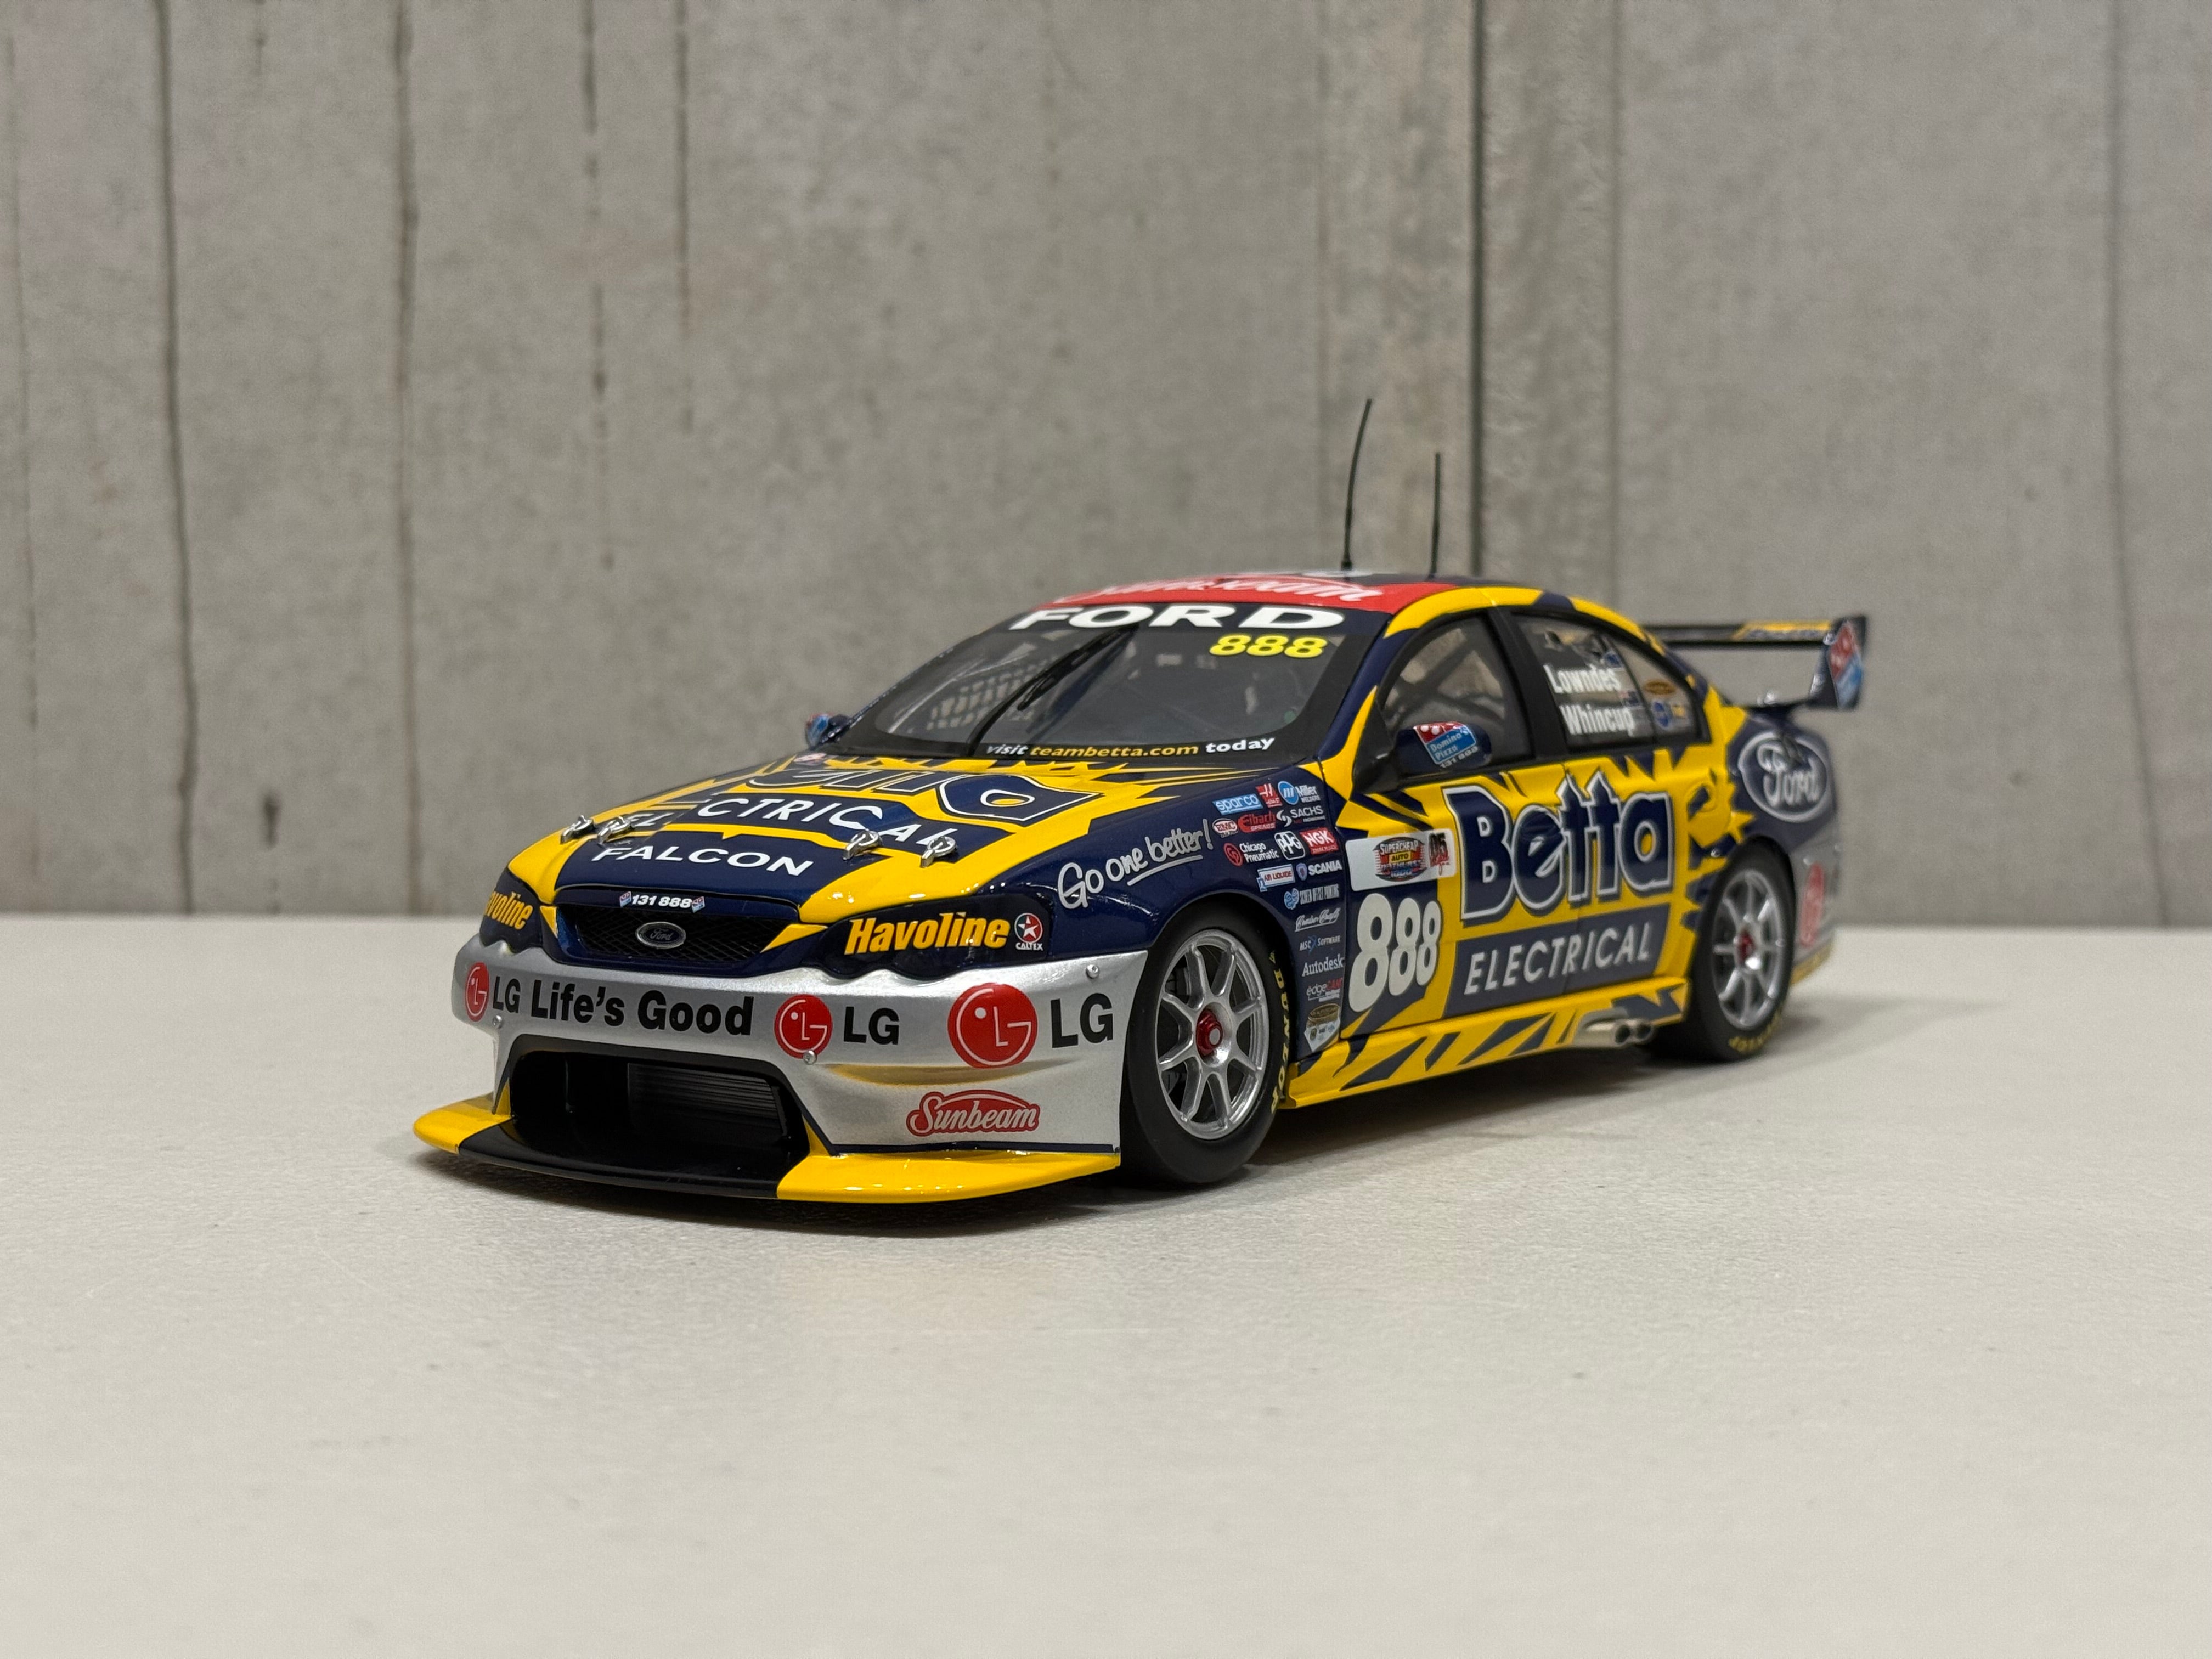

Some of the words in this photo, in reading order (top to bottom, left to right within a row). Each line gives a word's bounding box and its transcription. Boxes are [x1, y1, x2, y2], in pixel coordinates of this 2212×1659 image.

[1009, 604, 1344, 630] FORD
[1209, 634, 1328, 658] 888
[1543, 664, 1621, 694] Lowndes
[1559, 704, 1635, 737] Whincup
[986, 744, 1029, 755] visit
[1030, 744, 1199, 757] teambetta.com
[1205, 737, 1274, 753] today
[1430, 726, 1470, 752] Domino's
[1215, 795, 1259, 812] sparco
[1290, 805, 1324, 818] SACHS
[1216, 822, 1236, 832] BMC
[1303, 829, 1334, 847] NGK
[1239, 842, 1267, 853] Chicago
[1277, 833, 1302, 854] PPG
[1379, 840, 1419, 855] SUPERCHEAP
[1443, 771, 1672, 921] Betta
[591, 845, 814, 876] FALCON
[1058, 862, 1104, 909] Go
[1105, 848, 1148, 882] one
[1144, 819, 1214, 862] better!
[1244, 850, 1280, 863] Pneumatic
[1308, 860, 1342, 876] SCANIA
[1391, 853, 1409, 862] AUTO
[631, 894, 657, 905] 131
[658, 896, 692, 908] 888
[650, 927, 674, 940] Ford
[845, 912, 1011, 955] Havoline
[1299, 940, 1311, 951] MSC
[1015, 943, 1043, 951] CALTEX
[1348, 893, 1441, 1012] 888
[1464, 921, 1653, 995] ELECTRICAL
[1301, 953, 1344, 977] Autodesk
[493, 976, 521, 1014] LG
[531, 980, 625, 1026] Life's
[637, 990, 754, 1036] Good
[844, 1006, 899, 1045] LG
[1051, 993, 1114, 1048] LG
[910, 1094, 1036, 1133] Sunbeam
